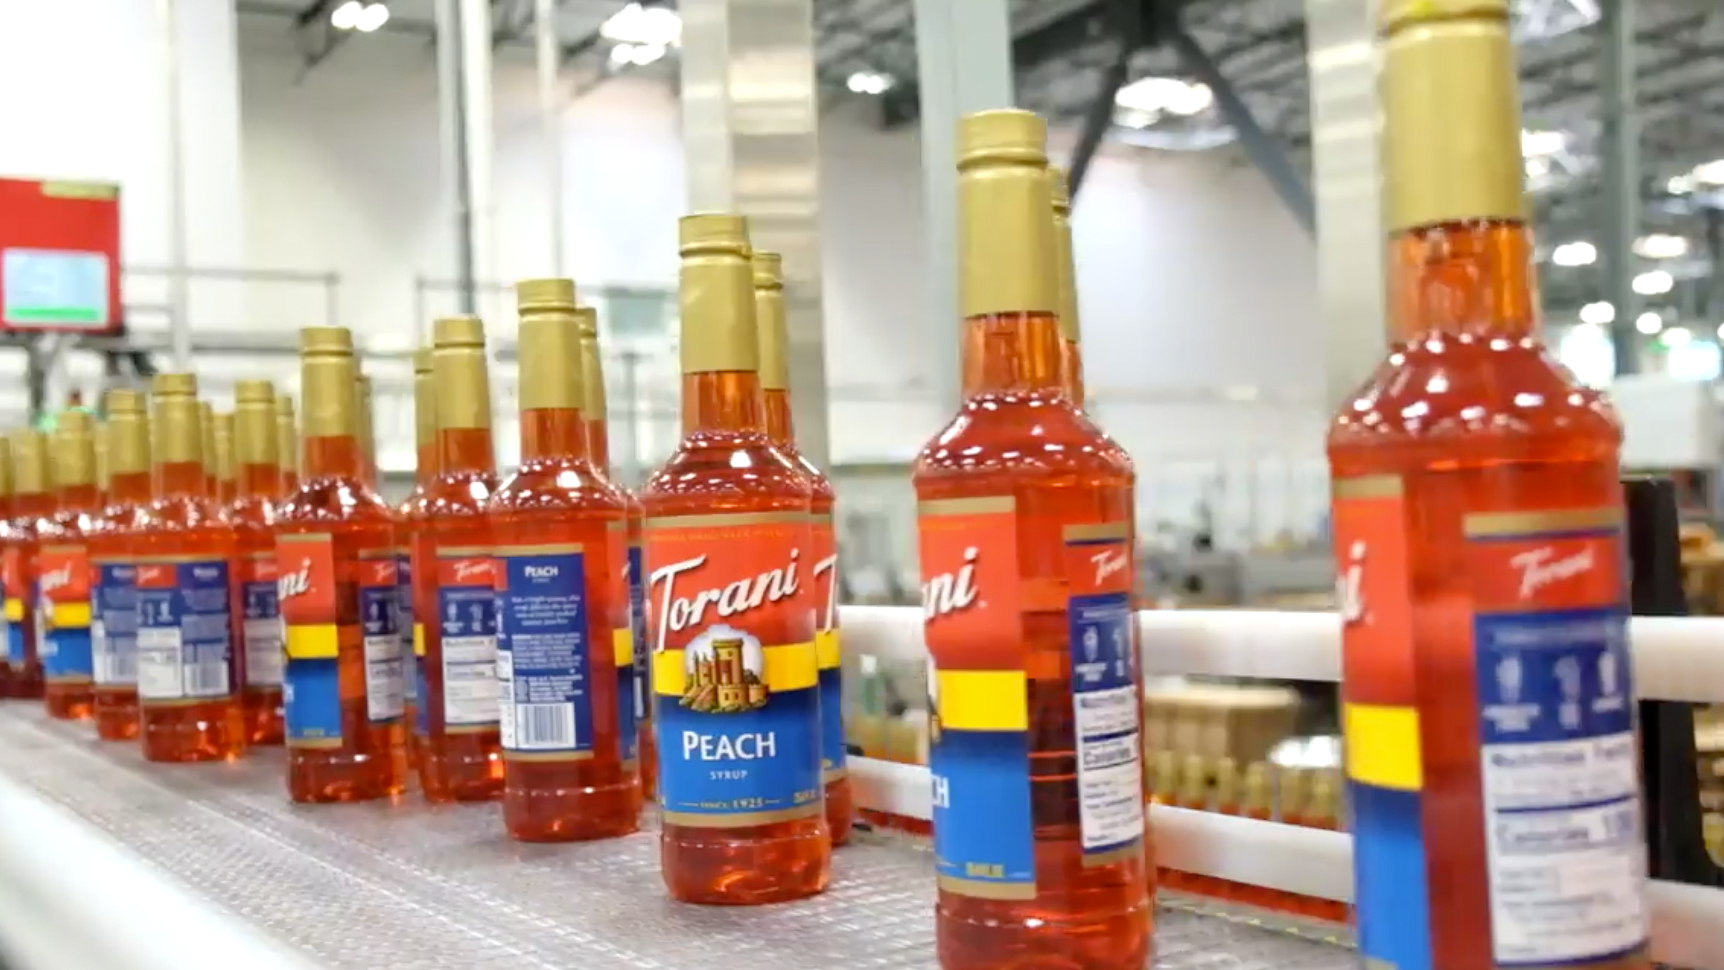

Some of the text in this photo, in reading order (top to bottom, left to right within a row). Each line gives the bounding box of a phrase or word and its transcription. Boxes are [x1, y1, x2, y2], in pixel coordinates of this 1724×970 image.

[525, 565, 559, 577] PEACH
[650, 547, 800, 654] Torani
[682, 730, 777, 761] PEACH
[709, 769, 749, 781] SYRUP
